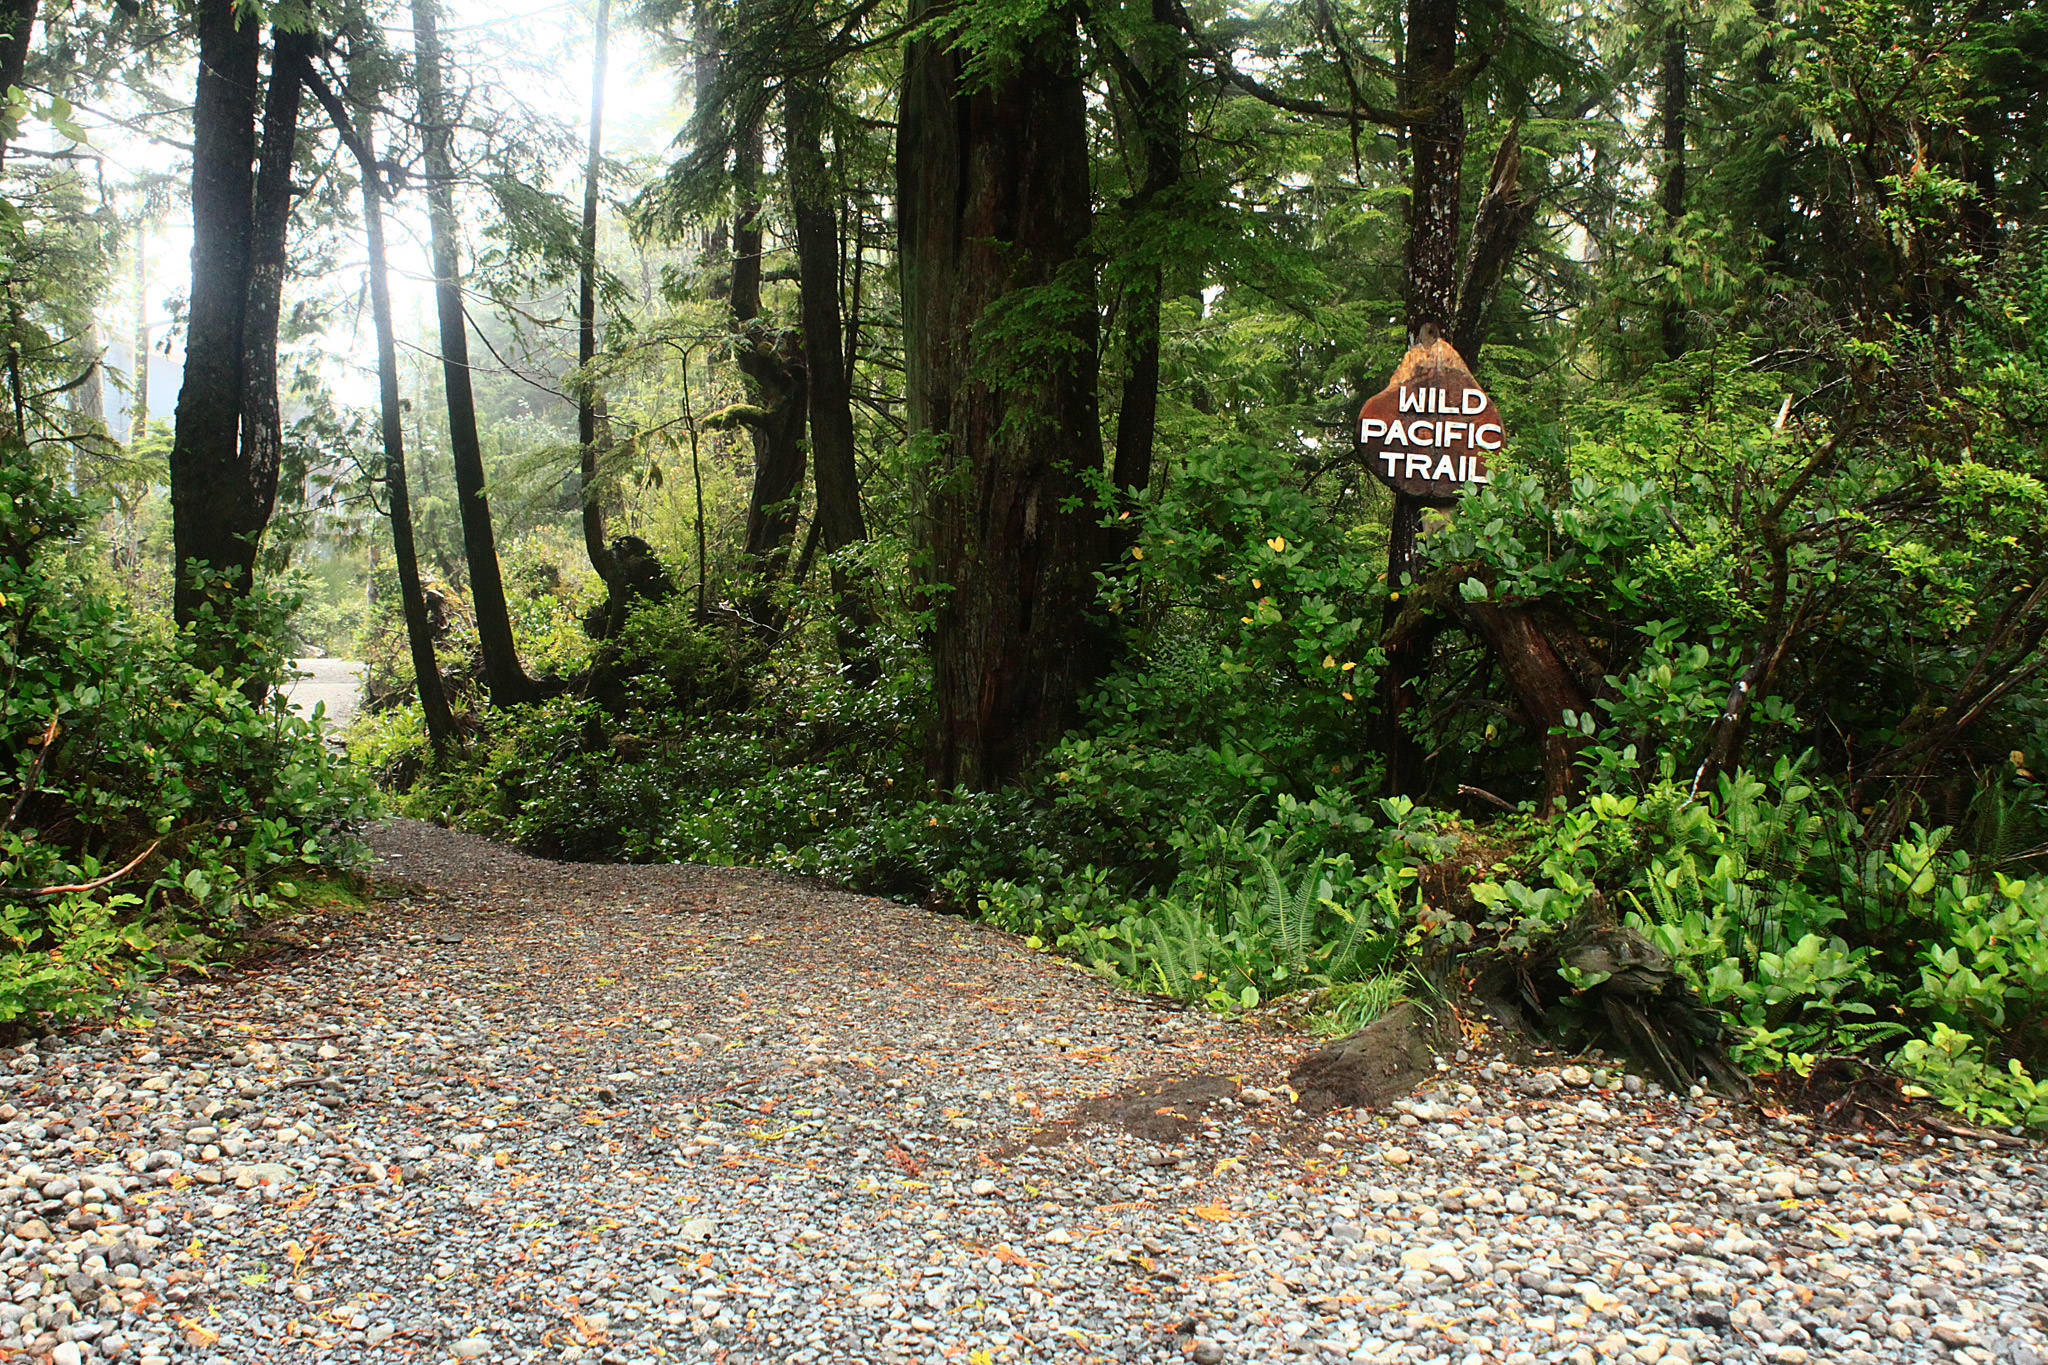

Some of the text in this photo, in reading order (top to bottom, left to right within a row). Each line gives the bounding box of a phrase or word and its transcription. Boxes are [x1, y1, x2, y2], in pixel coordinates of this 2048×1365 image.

[1398, 386, 1488, 415] WILD
[1360, 418, 1502, 450] PACIFIC
[1379, 451, 1490, 484] TRAIL
